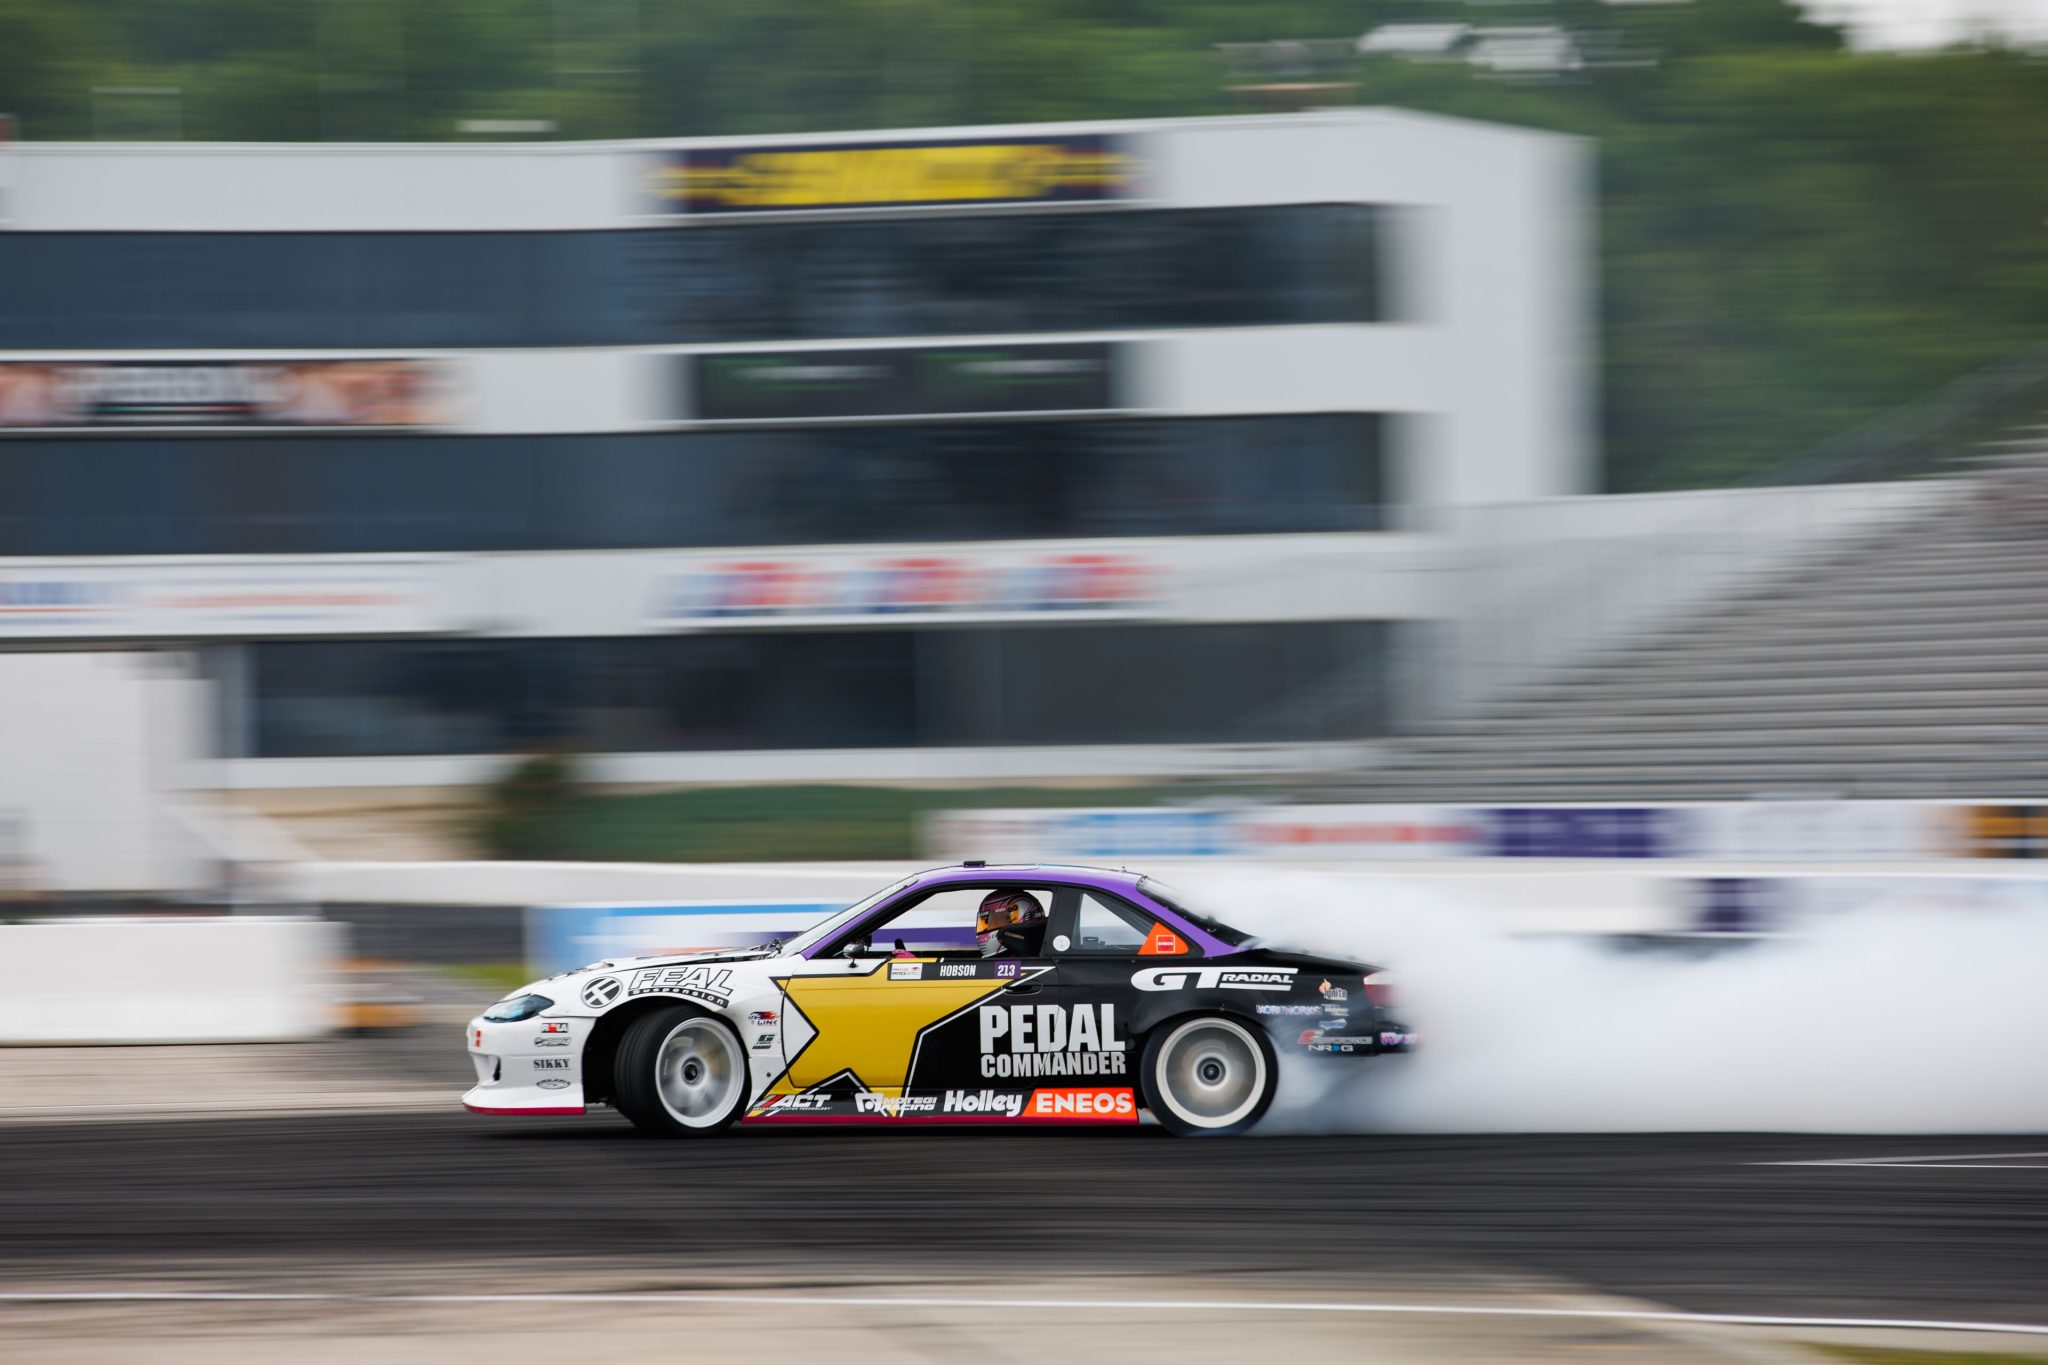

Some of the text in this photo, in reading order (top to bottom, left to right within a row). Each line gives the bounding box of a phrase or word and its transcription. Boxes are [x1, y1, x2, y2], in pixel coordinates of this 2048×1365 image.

[940, 965, 976, 977] HOBSON
[997, 965, 1016, 977] 213
[1221, 973, 1294, 984] RADIAL
[628, 967, 733, 996] FEAL
[980, 1003, 1126, 1054] PEDAL
[533, 1059, 570, 1069] SIKKY
[981, 1051, 1126, 1078] COMMANDER
[770, 1094, 832, 1108] ACT
[943, 1090, 1023, 1117] Holley
[1036, 1093, 1132, 1113] ENEOS
